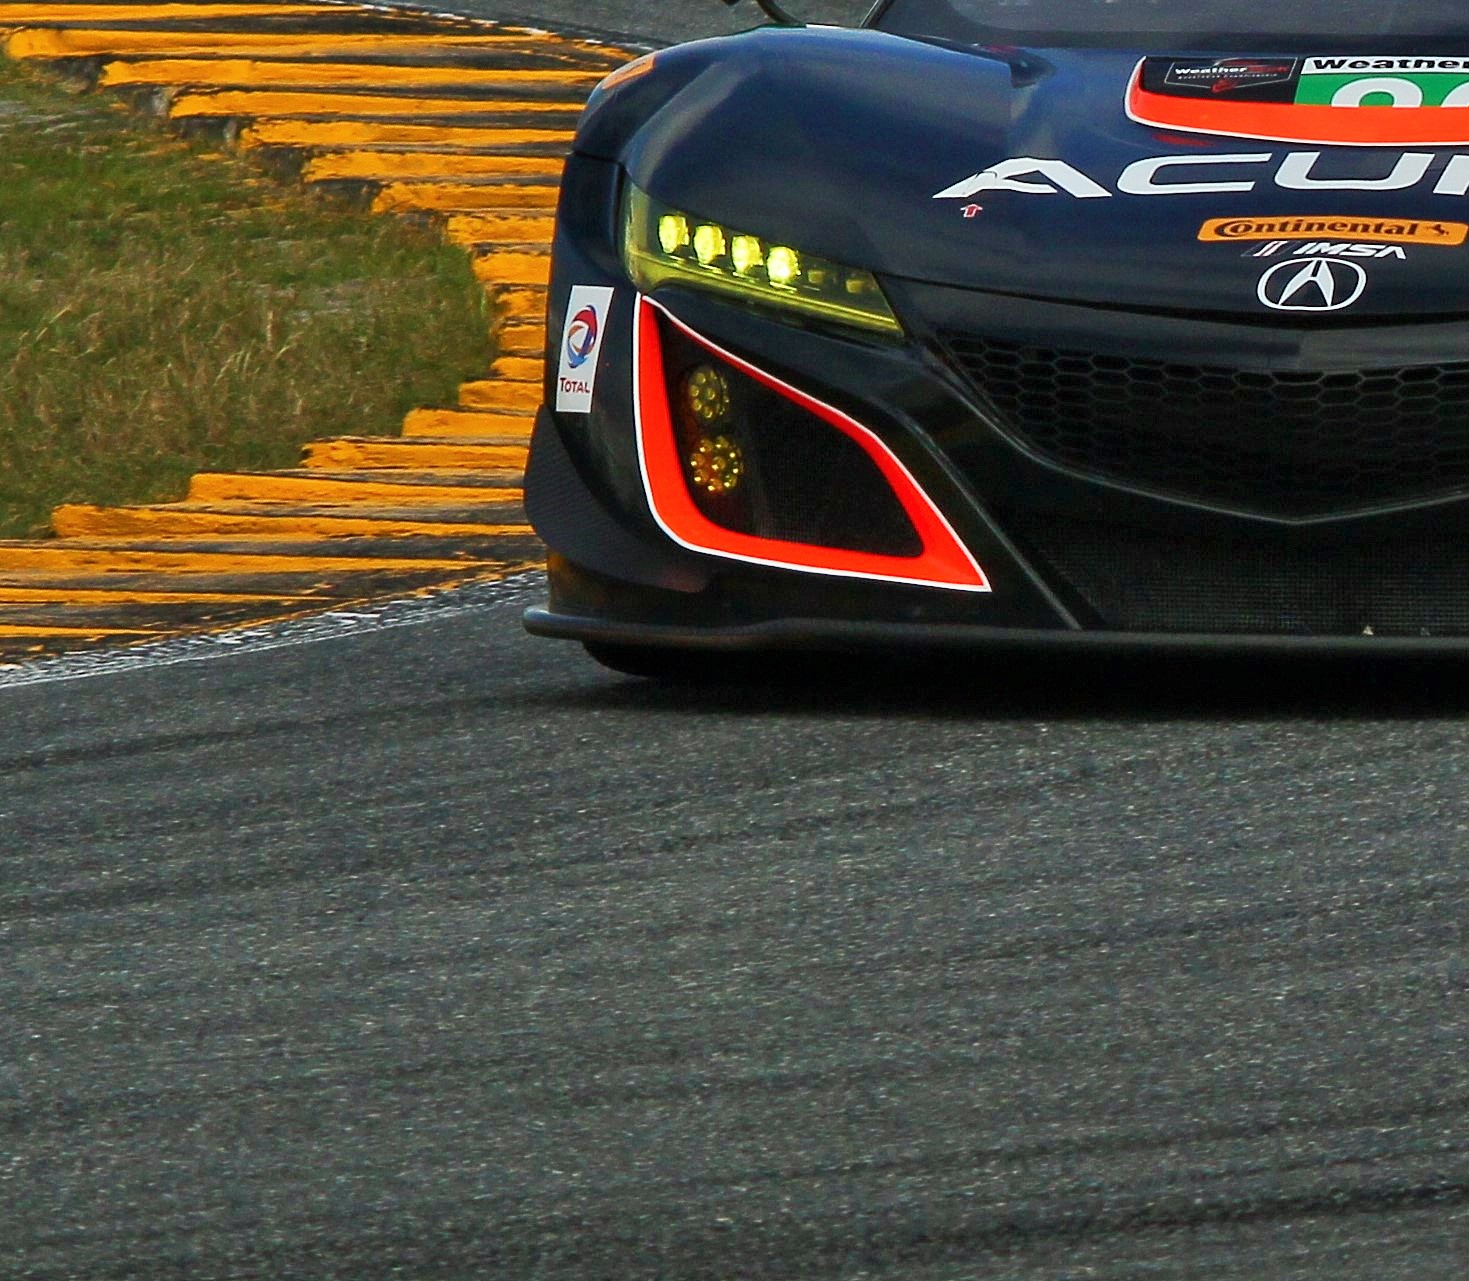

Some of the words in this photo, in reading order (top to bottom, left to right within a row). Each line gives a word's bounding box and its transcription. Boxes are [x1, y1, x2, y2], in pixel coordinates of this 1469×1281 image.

[1213, 219, 1418, 238] Continental
[1293, 242, 1407, 260] IMSA
[559, 377, 591, 394] TOTAL
